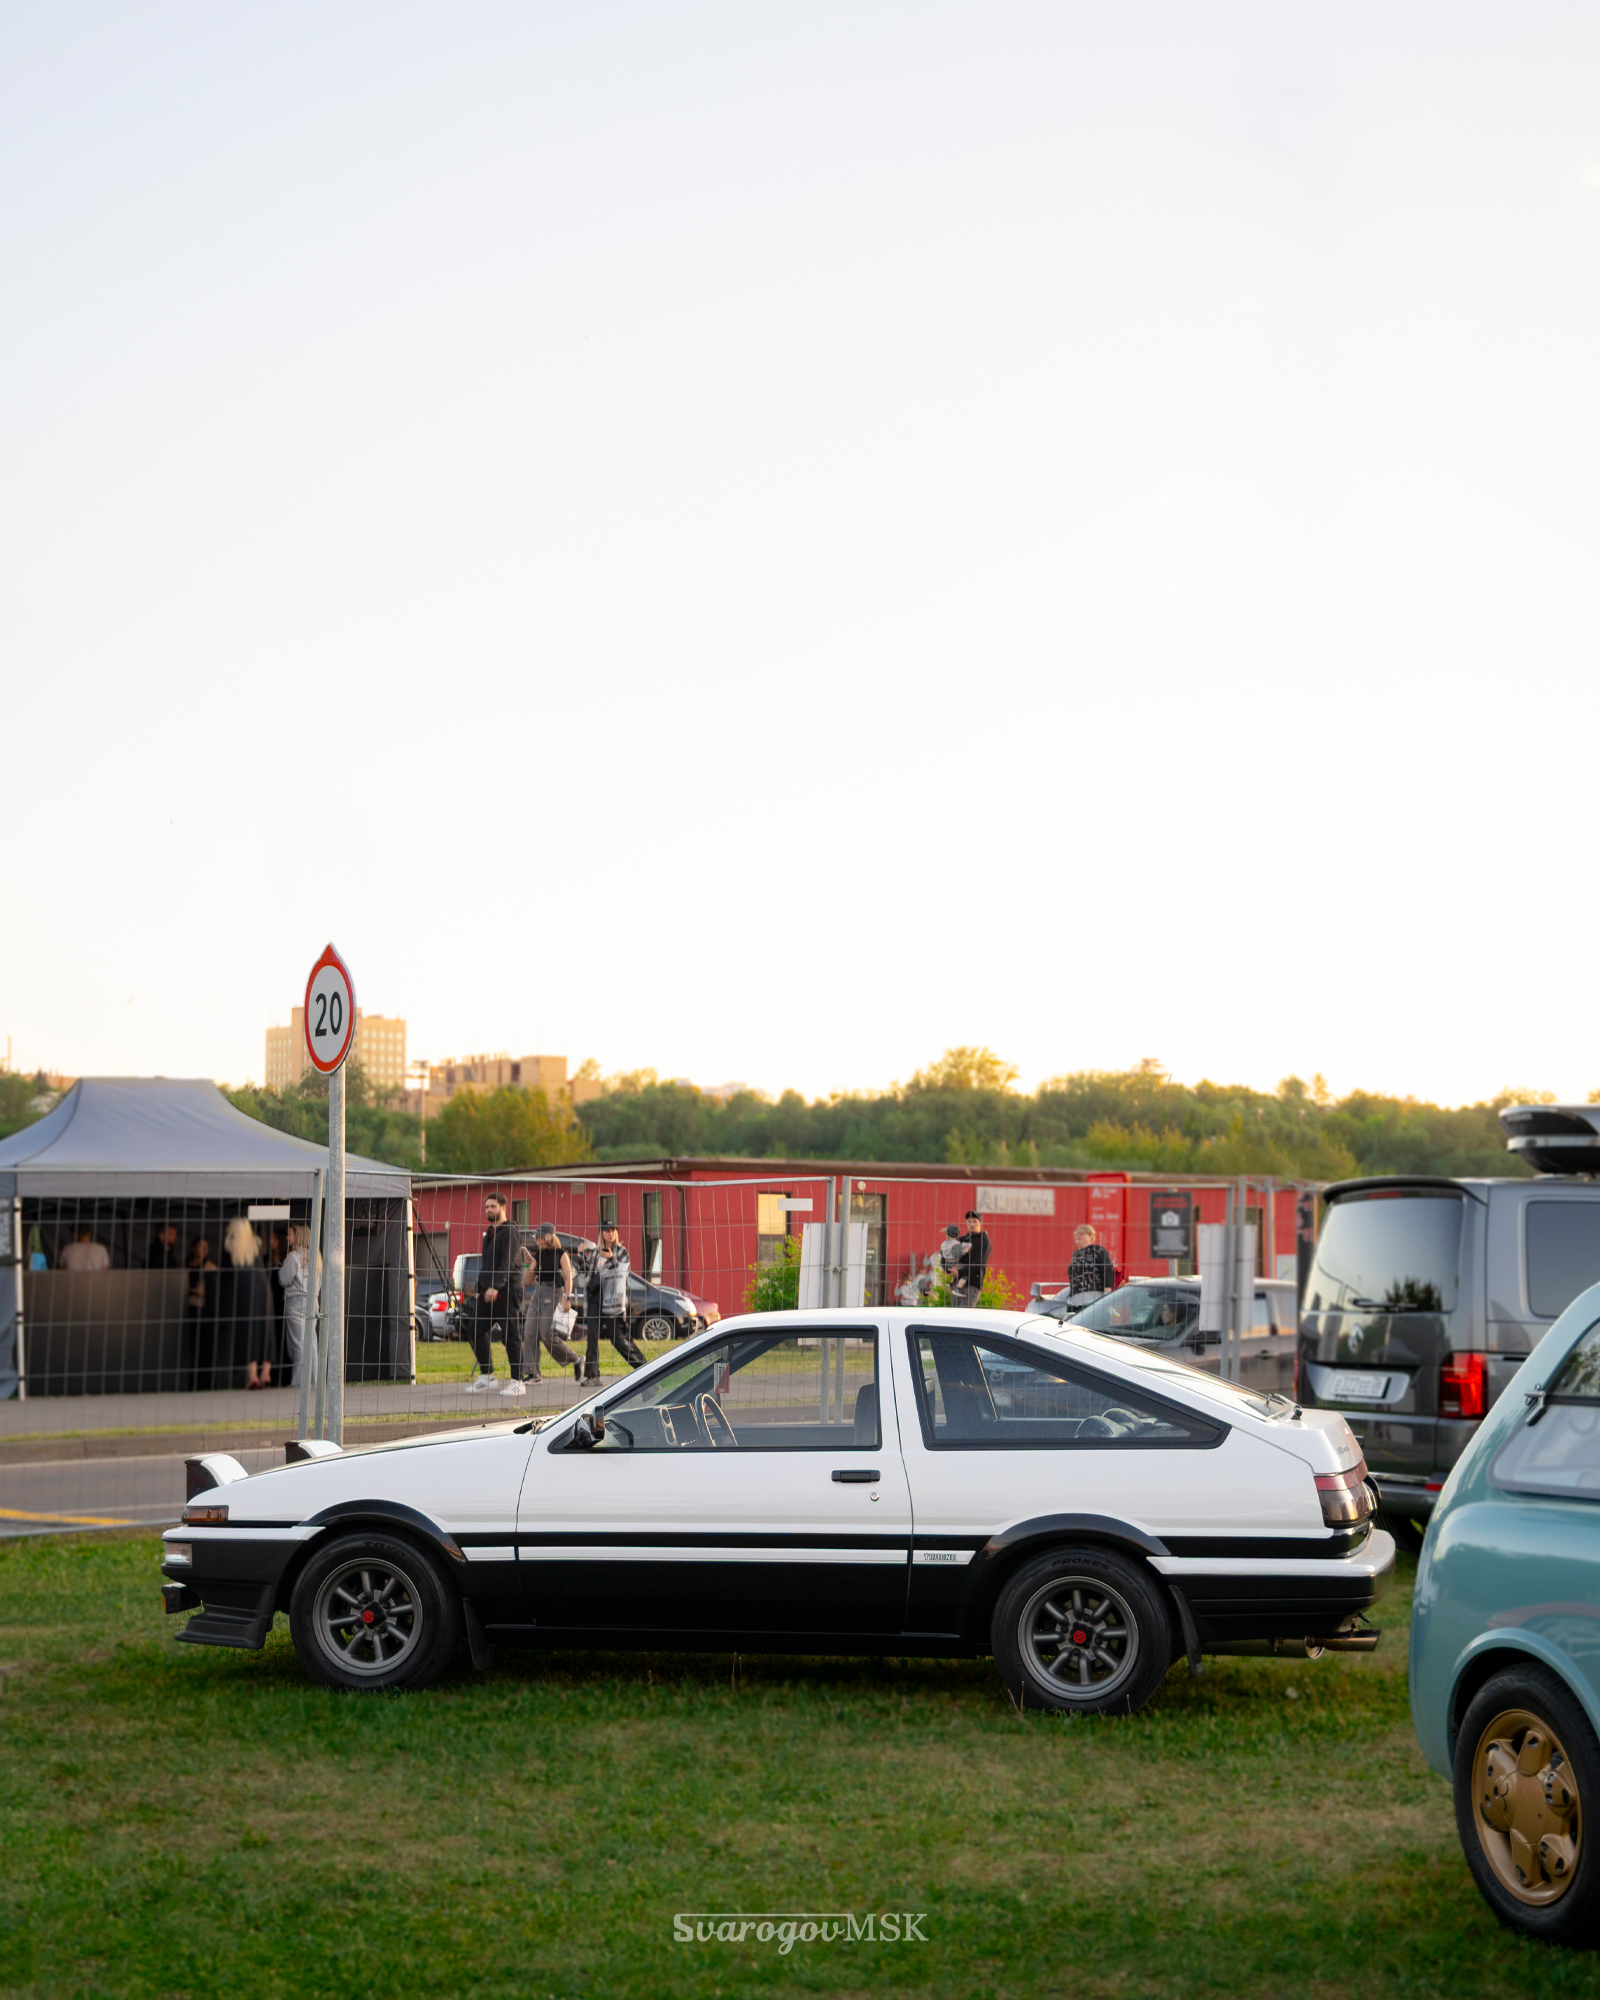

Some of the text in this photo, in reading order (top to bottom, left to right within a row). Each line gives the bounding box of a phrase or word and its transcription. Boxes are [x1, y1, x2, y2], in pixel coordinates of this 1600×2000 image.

[315, 991, 343, 1037] 20
[924, 1552, 957, 1561] TRUENO
[1052, 1557, 1111, 1570] PROXES
